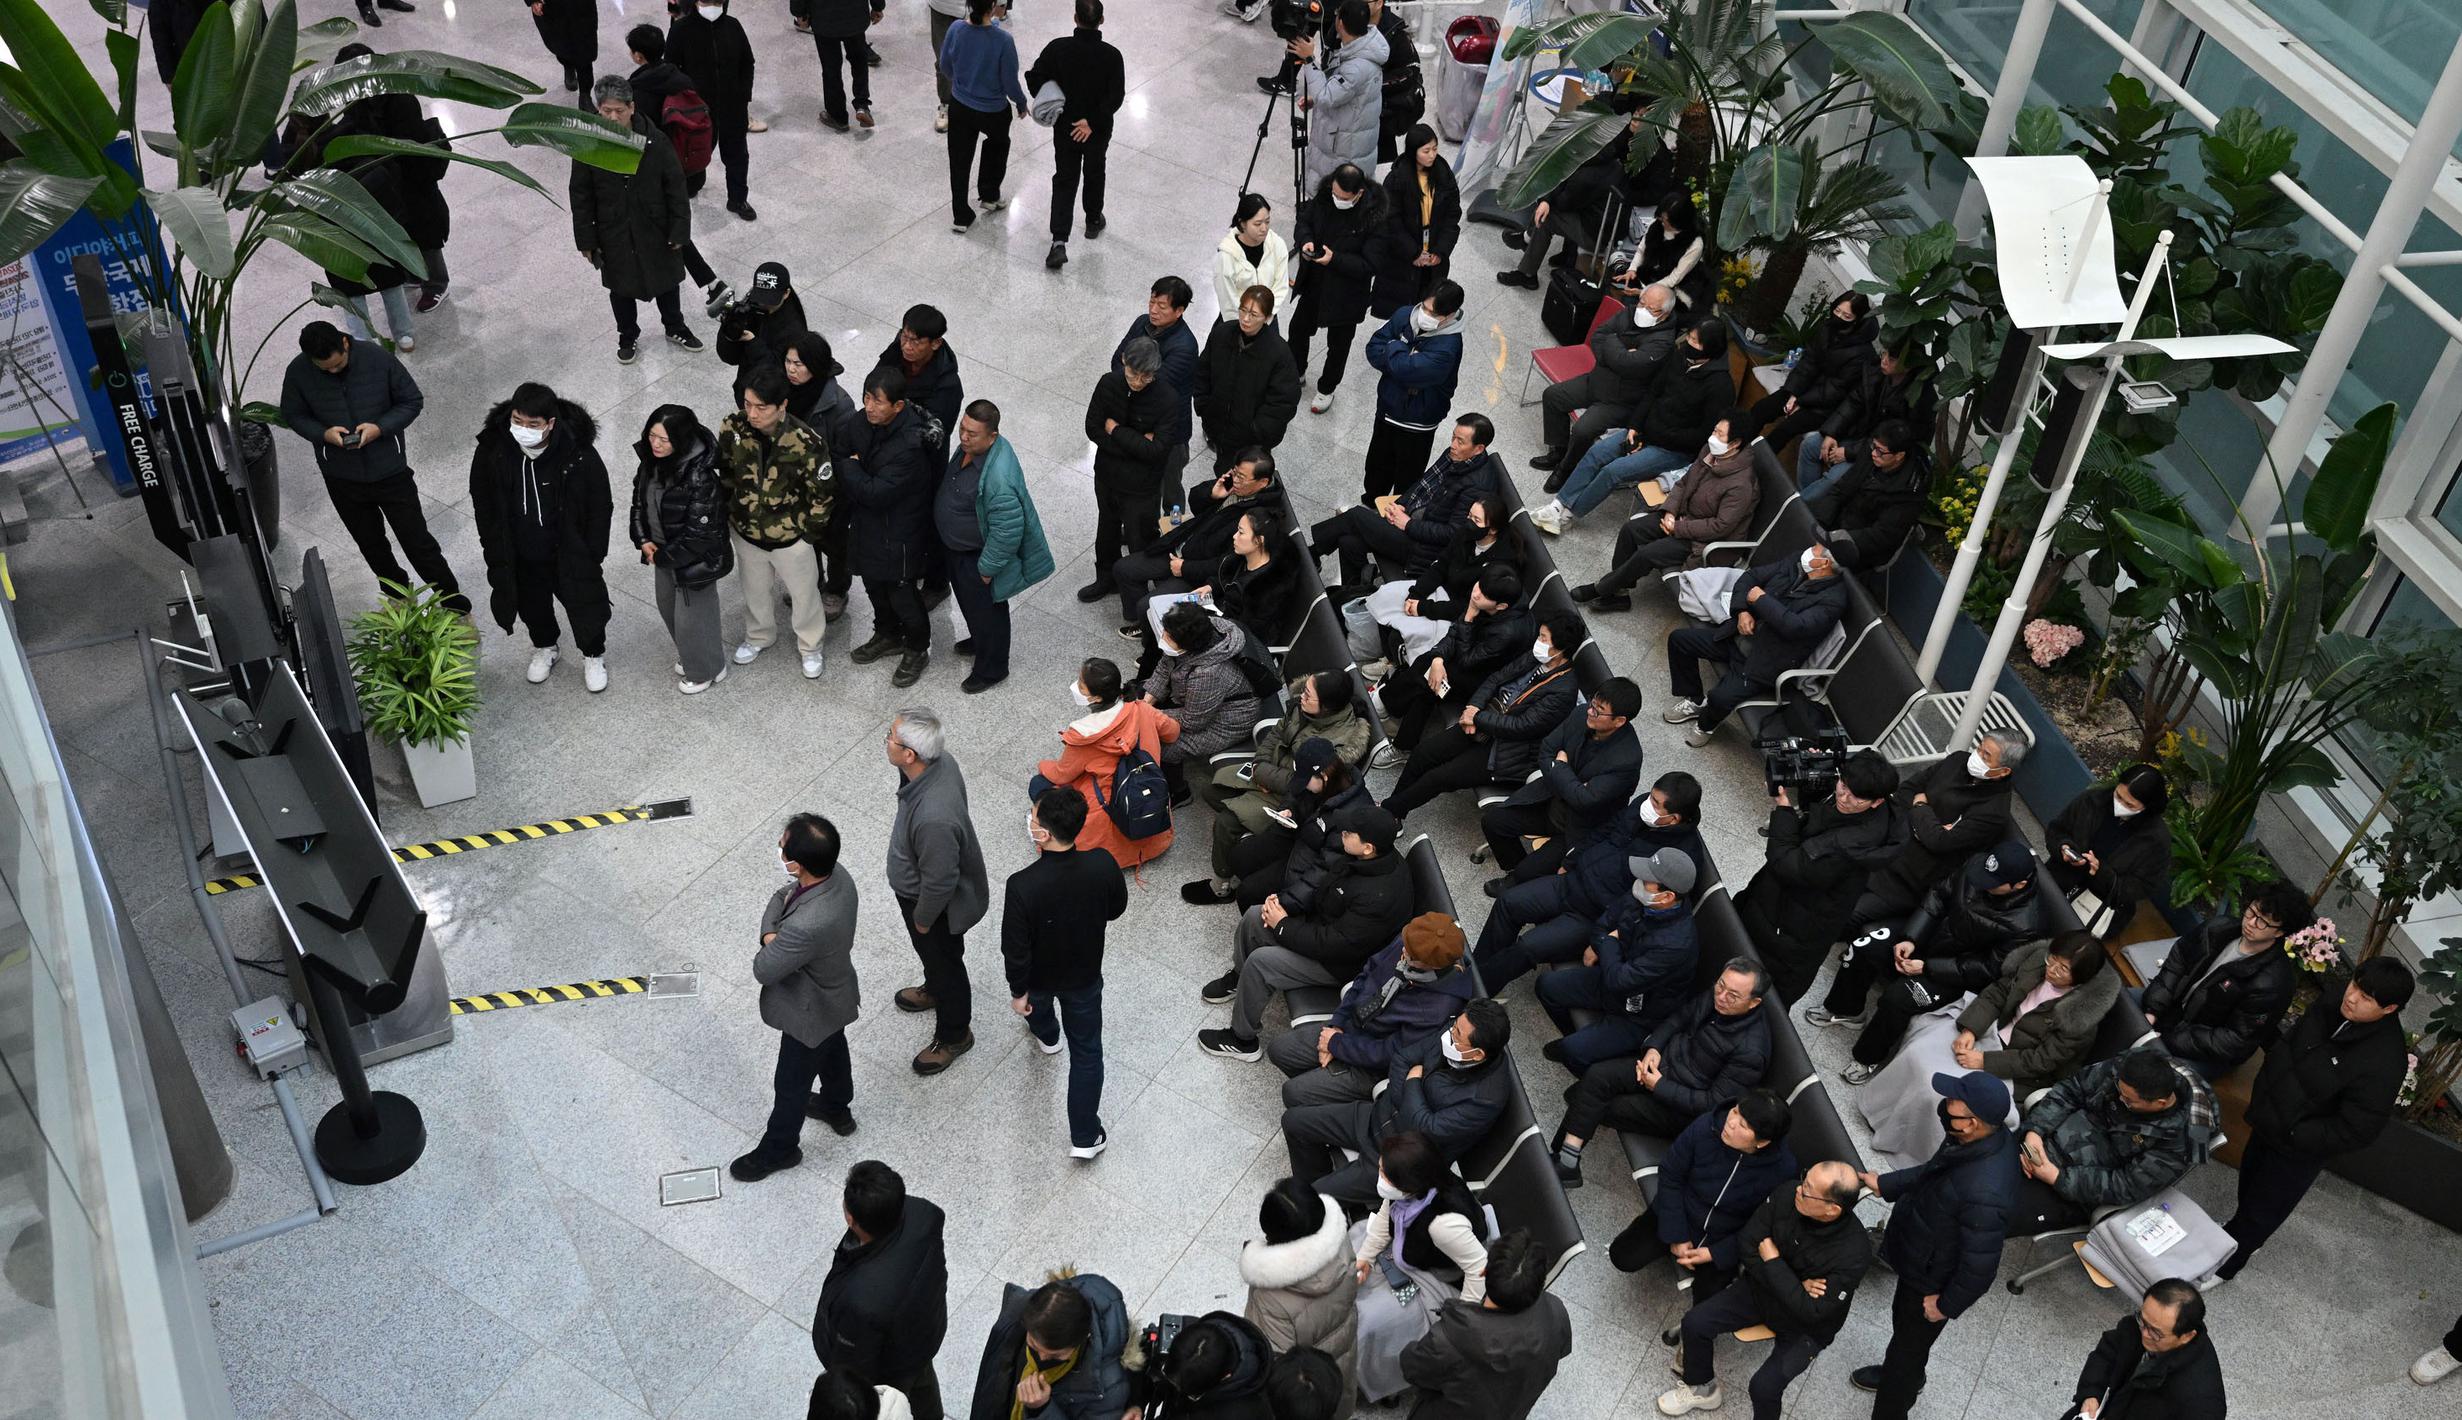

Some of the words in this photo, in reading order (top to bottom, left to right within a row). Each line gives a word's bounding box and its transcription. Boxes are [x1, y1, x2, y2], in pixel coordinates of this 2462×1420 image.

[63, 253, 153, 297] 무국제
[119, 403, 142, 435] FREE
[130, 436, 160, 489] CHARGE
